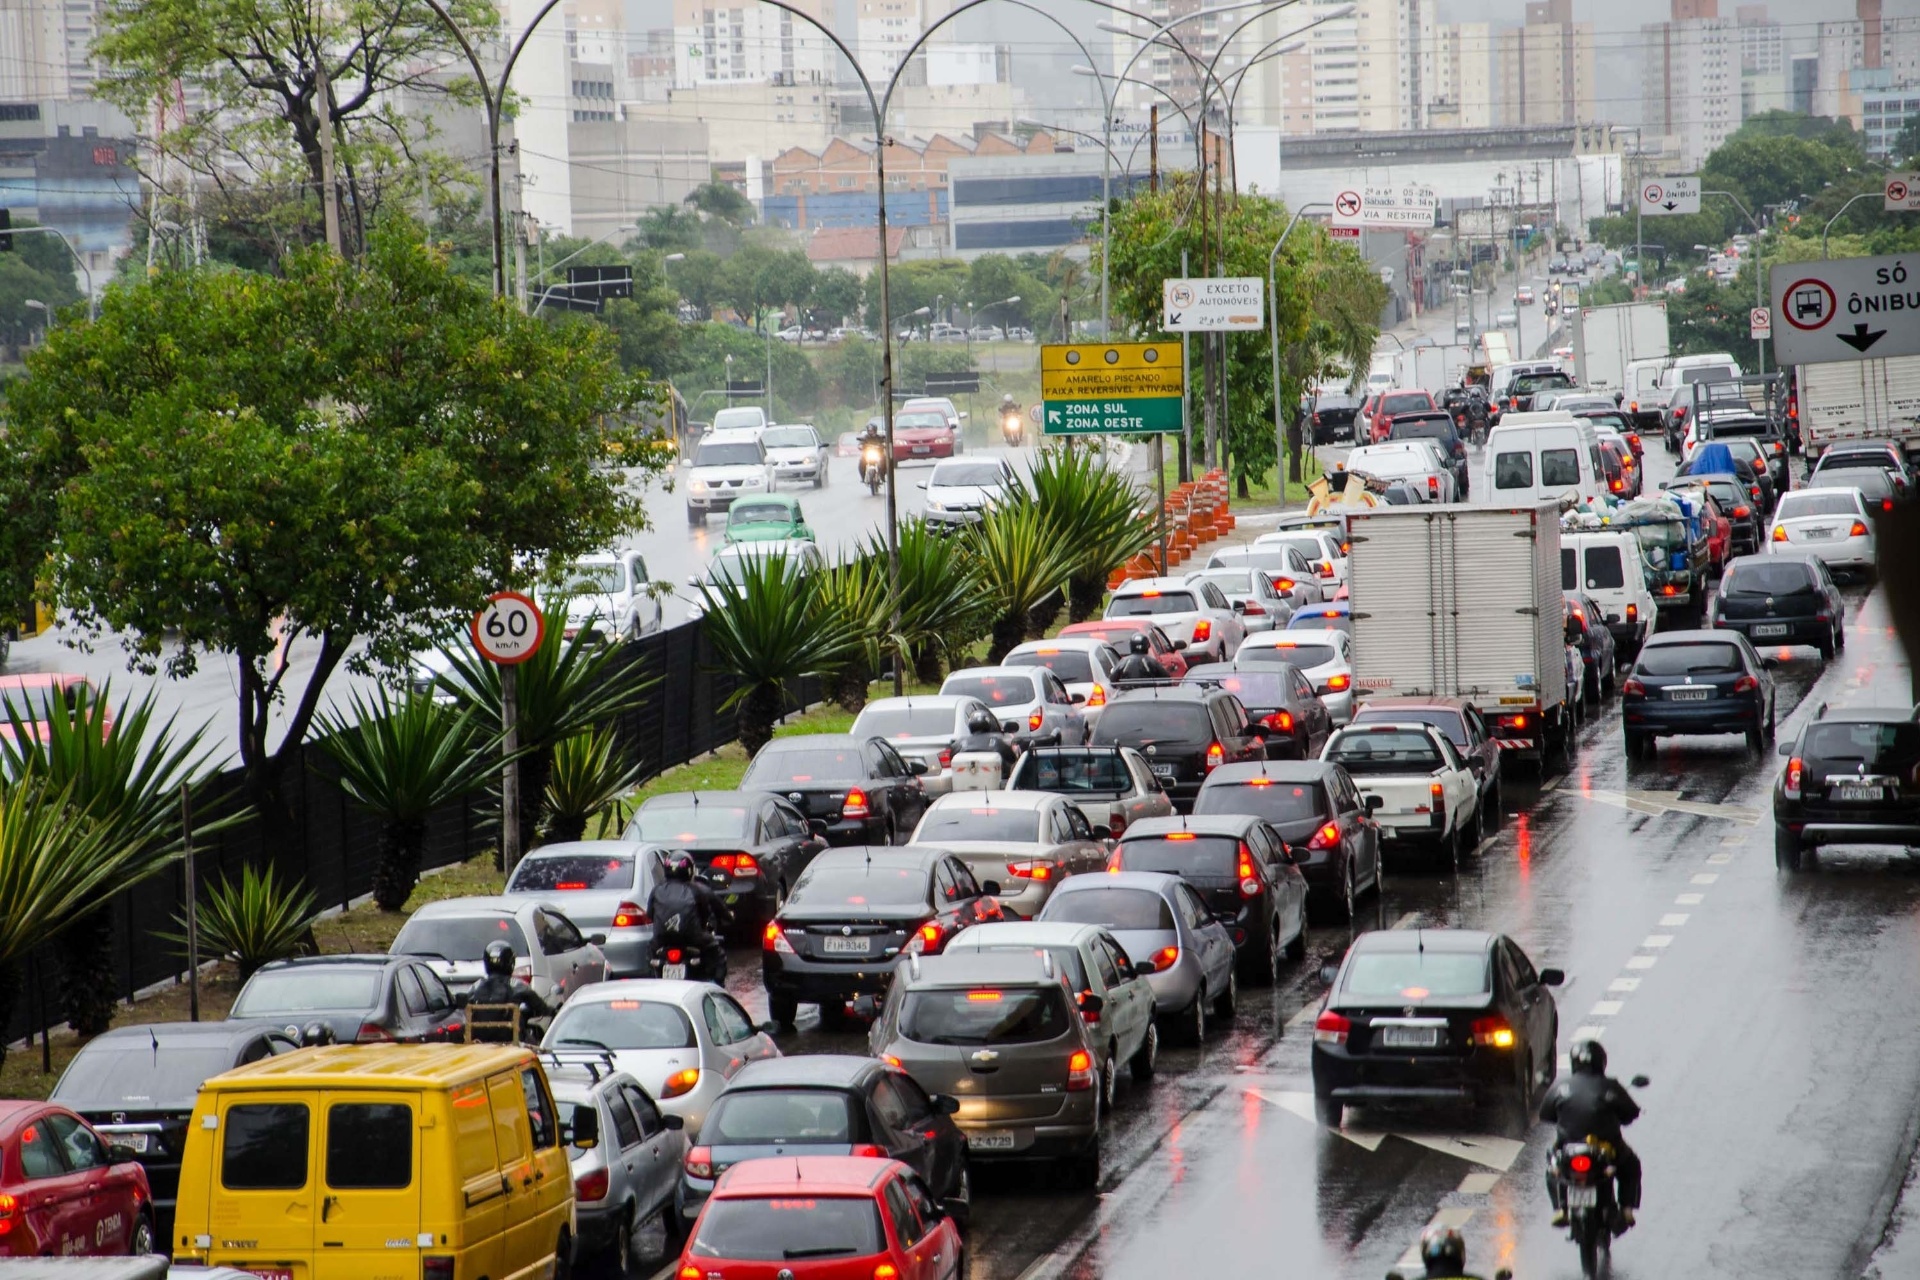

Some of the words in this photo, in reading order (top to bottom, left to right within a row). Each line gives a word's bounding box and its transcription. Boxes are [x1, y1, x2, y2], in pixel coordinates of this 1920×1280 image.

[1077, 136, 1116, 148] SANA
[1665, 190, 1698, 199] ÔNIBUS
[1363, 211, 1380, 219] VIA
[1386, 211, 1432, 221] RESTRITA
[1876, 260, 1907, 286] SÓ
[1206, 284, 1250, 294] EXCETO
[1198, 297, 1259, 307] AUTOMÓVEIS
[1066, 375, 1111, 384] AMARELO
[1114, 373, 1161, 383] PISCANDO
[1045, 387, 1074, 396] FAIXA
[1077, 384, 1135, 394] REVERSÍVEL
[1138, 383, 1182, 393] ATIVADA
[1065, 404, 1100, 415] ZONA
[1104, 403, 1128, 414] SUL
[1065, 418, 1100, 429] ZONA
[1104, 417, 1144, 428] OESTE
[486, 609, 528, 637] 60
[495, 640, 520, 649] km/h
